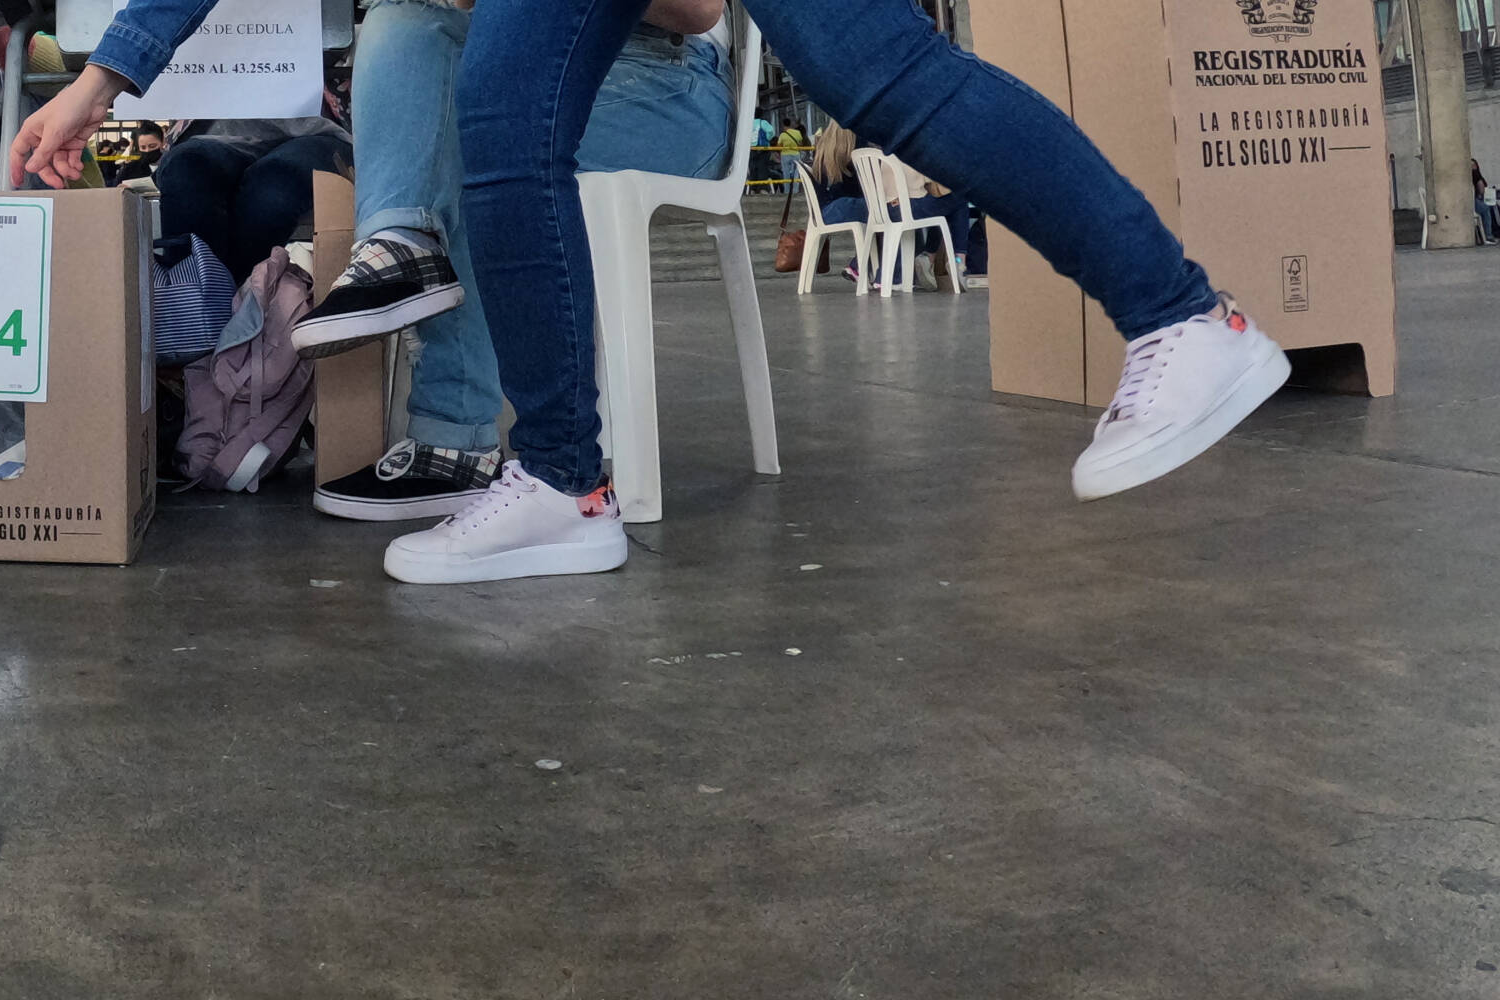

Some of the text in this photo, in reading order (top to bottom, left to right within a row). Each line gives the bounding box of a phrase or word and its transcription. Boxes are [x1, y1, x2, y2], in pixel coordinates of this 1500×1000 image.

[215, 23, 233, 35] DE
[237, 23, 294, 35] CEDULA
[1193, 42, 1367, 71] REGISTRADURÍA
[208, 63, 228, 74] AL
[232, 62, 296, 74] 43.255.483
[1195, 71, 1368, 87] NACIONAL DEL ESTADO CIVIL
[1200, 104, 1370, 132] LA REGISTRADURÍA
[1202, 136, 1326, 168] DEL SIGLO XXI
[33, 524, 58, 541] XXI
